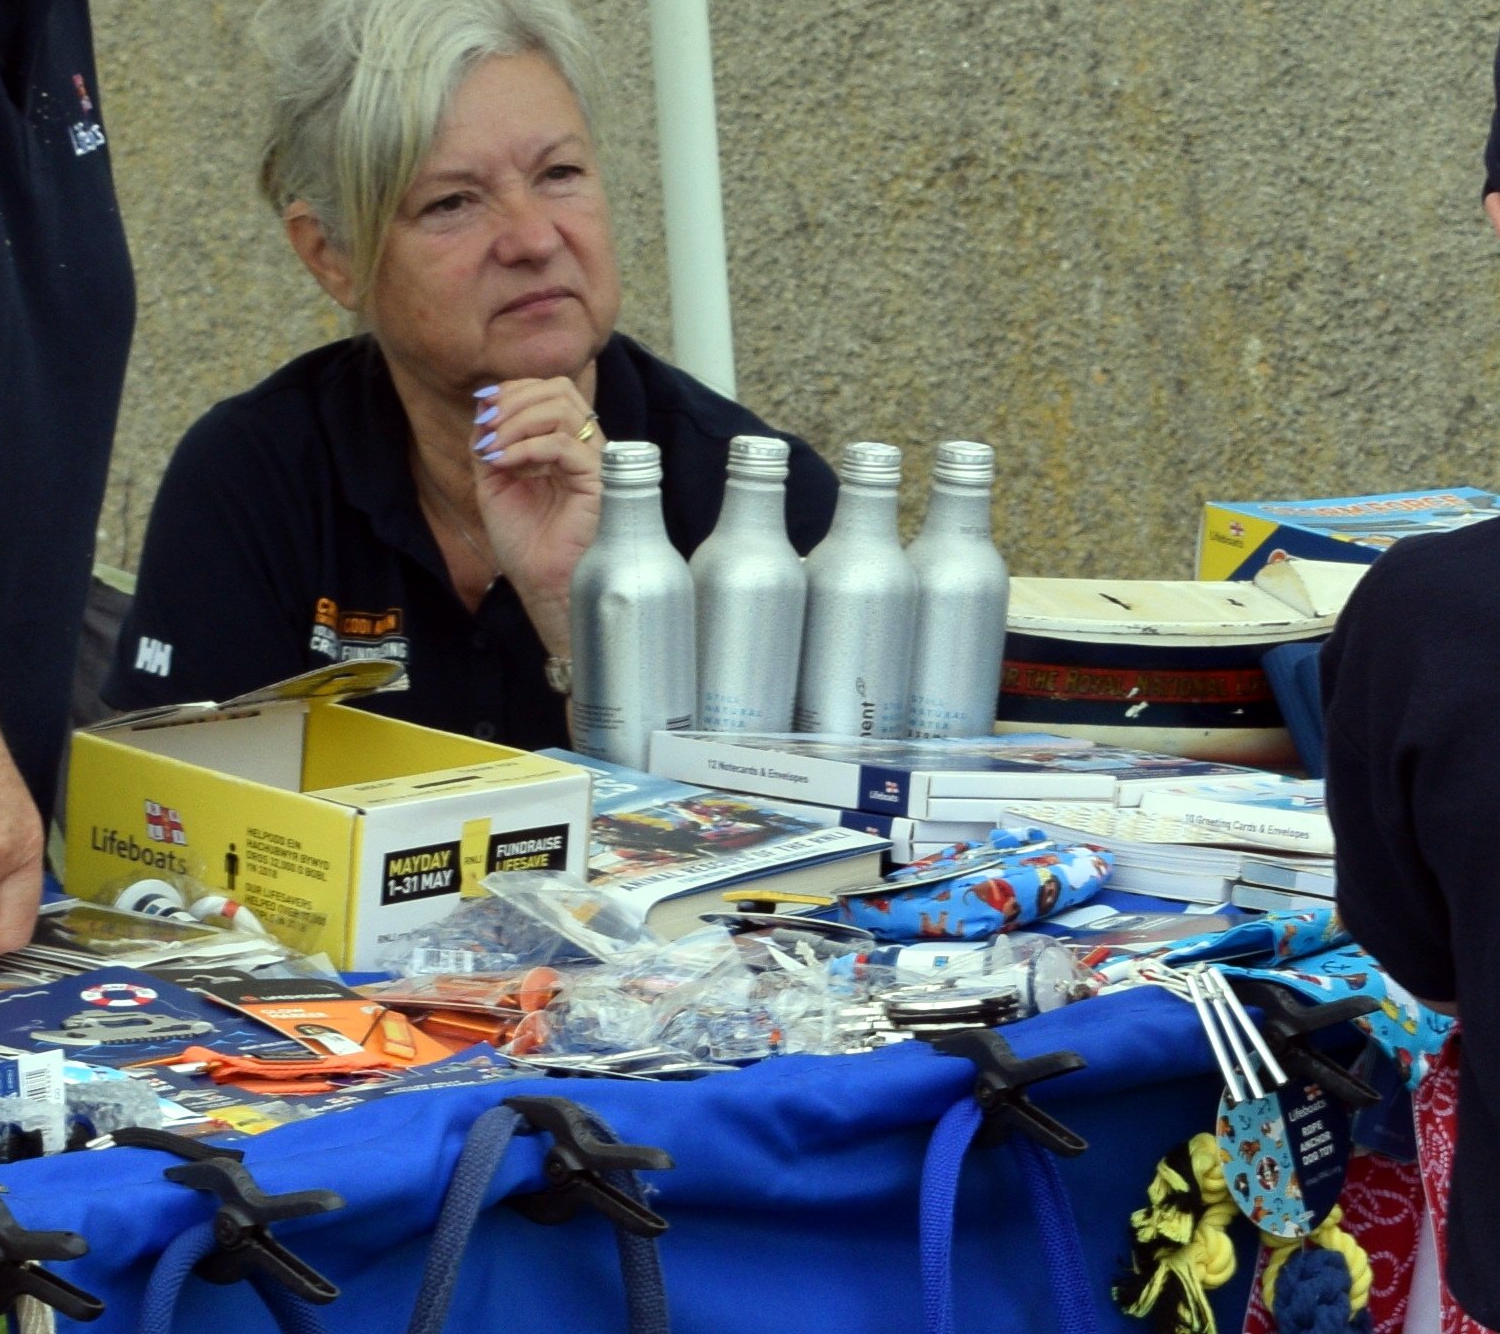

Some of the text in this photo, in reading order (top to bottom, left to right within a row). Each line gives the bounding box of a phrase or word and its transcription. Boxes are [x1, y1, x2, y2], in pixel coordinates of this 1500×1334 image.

[718, 760, 758, 777] Notecards
[768, 768, 809, 784] Envelopes
[1232, 820, 1257, 833] Cards
[1268, 824, 1309, 840] Envelopes
[90, 825, 188, 876] Lifeboats
[496, 835, 564, 858] FUNDRAISE
[388, 849, 452, 877] MAYDAY
[421, 868, 454, 890] MAY
